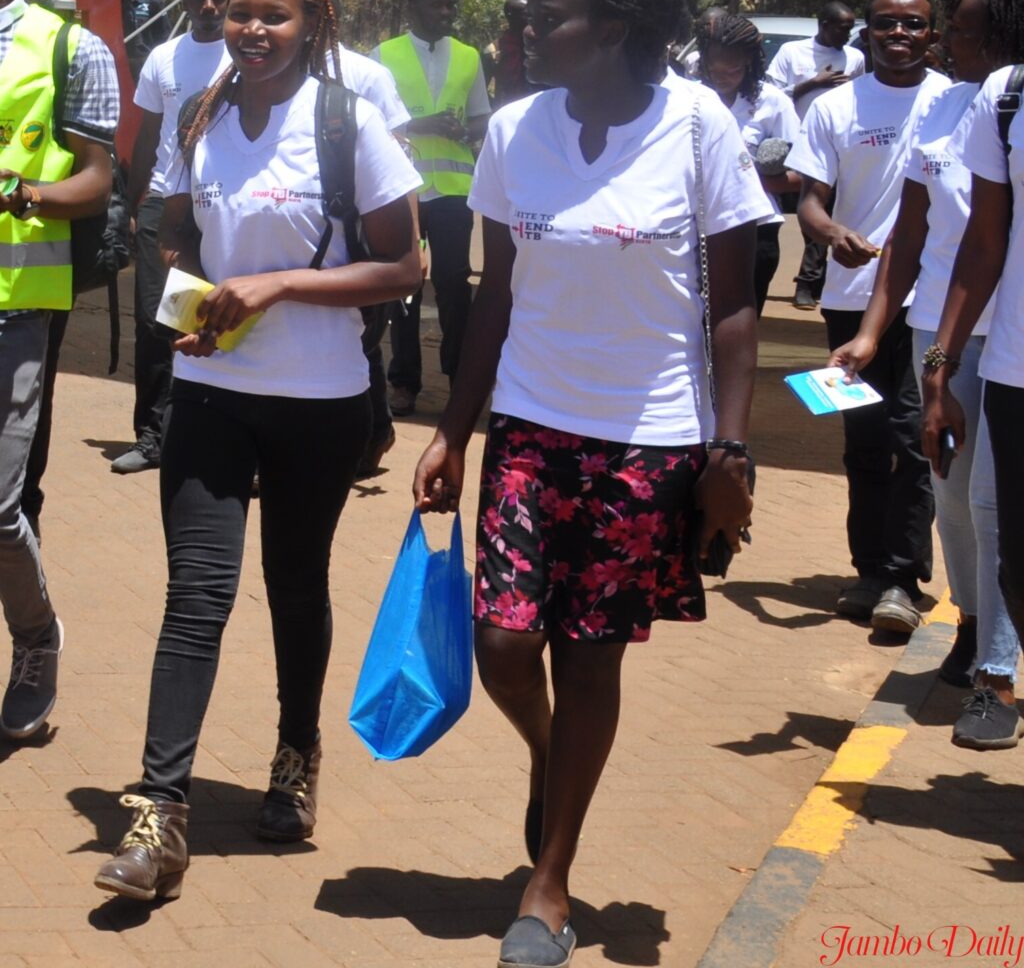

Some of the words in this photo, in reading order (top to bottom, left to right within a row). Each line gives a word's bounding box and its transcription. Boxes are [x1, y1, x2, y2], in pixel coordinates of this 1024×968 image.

[858, 128, 882, 136] UNITE
[876, 132, 897, 140] END
[202, 191, 222, 200] END
[202, 199, 212, 208] TB
[540, 213, 556, 222] TO
[526, 222, 554, 232] END
[592, 225, 615, 236] Stop
[525, 232, 542, 240] TB
